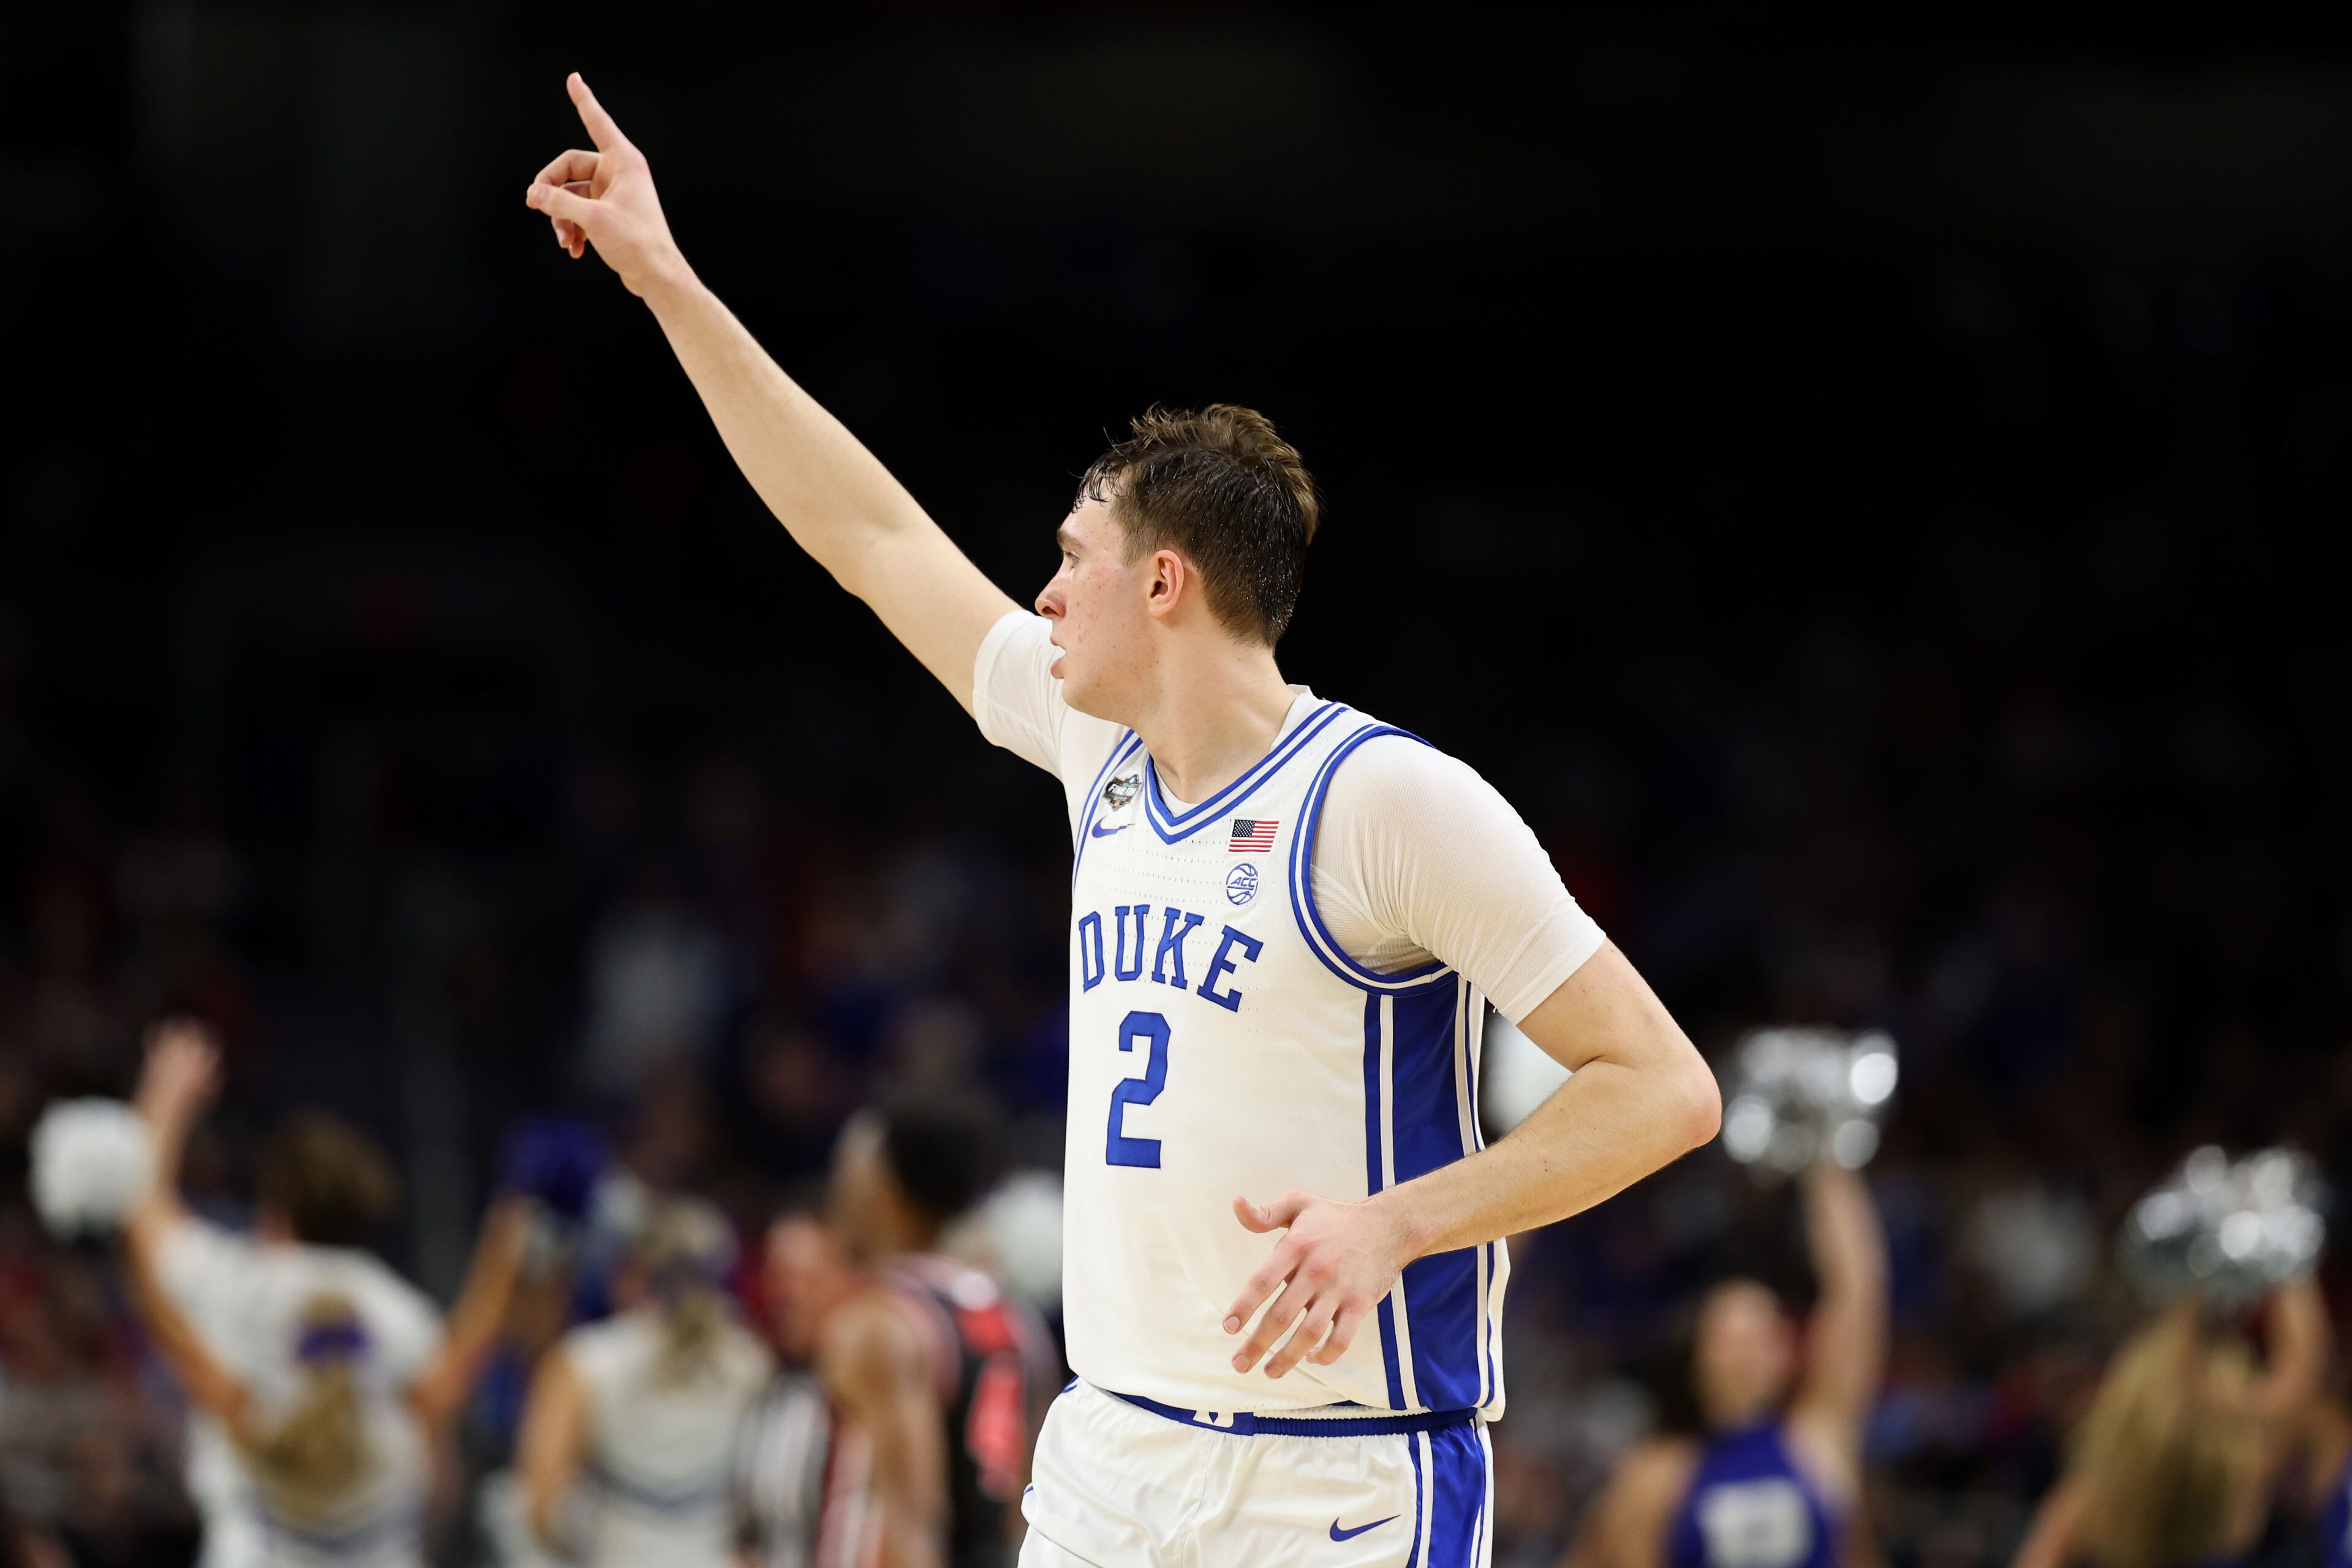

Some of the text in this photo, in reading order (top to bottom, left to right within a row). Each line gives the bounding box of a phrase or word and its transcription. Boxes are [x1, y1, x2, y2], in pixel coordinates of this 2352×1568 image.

[1230, 876, 1258, 888] ACC
[1079, 904, 1264, 1012] DUKE
[1106, 1011, 1171, 1169] 2
